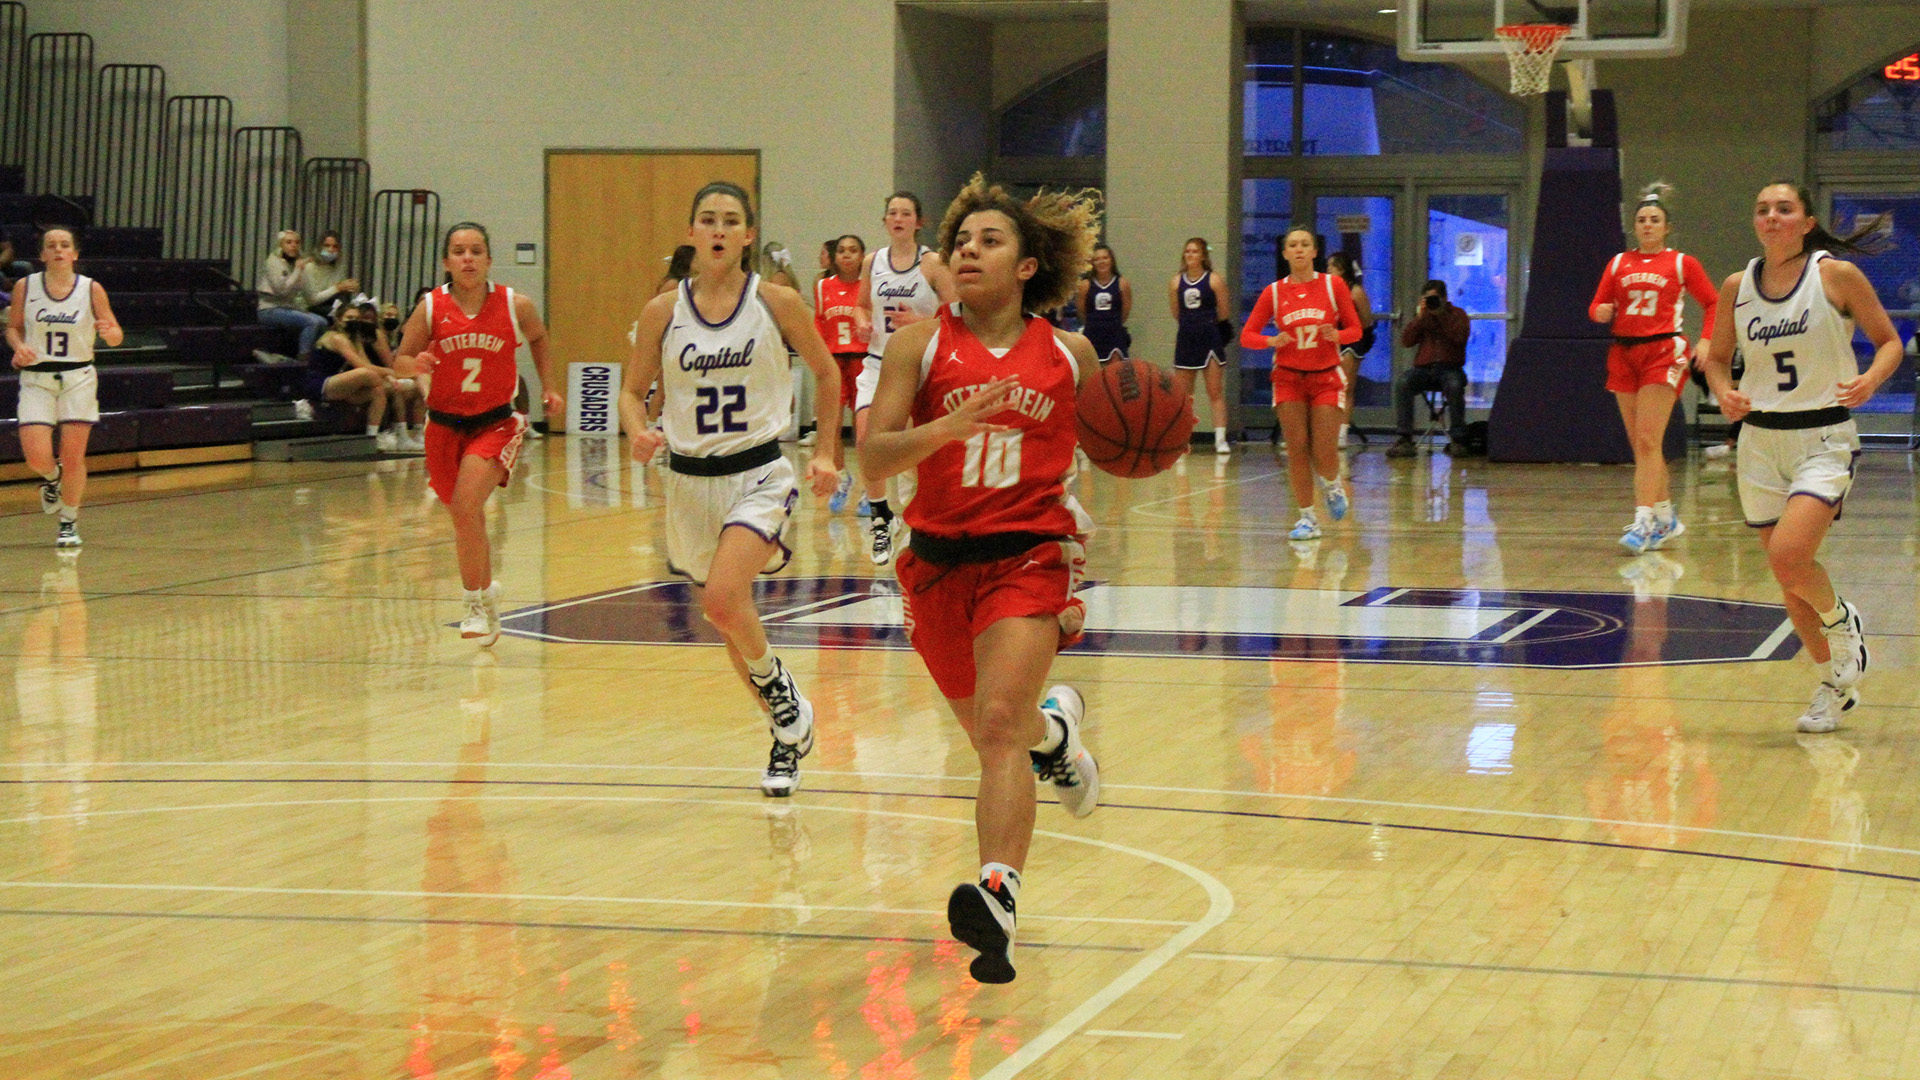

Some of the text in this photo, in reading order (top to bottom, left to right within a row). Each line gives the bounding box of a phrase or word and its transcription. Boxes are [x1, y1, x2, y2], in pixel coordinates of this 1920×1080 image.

[877, 281, 918, 301] Capital
[1626, 290, 1658, 316] 23
[36, 308, 79, 326] Capital
[1747, 309, 1809, 346] Capital
[46, 332, 68, 357] 13
[440, 333, 506, 353] OTTERBEIN
[837, 322, 851, 345] 5
[1296, 325, 1318, 349] 12
[679, 338, 755, 378] Capital
[1772, 351, 1798, 391] 5
[461, 358, 482, 392] 2
[579, 366, 611, 432] CRUSADERS
[696, 385, 748, 434] 22
[961, 428, 1024, 488] 10
